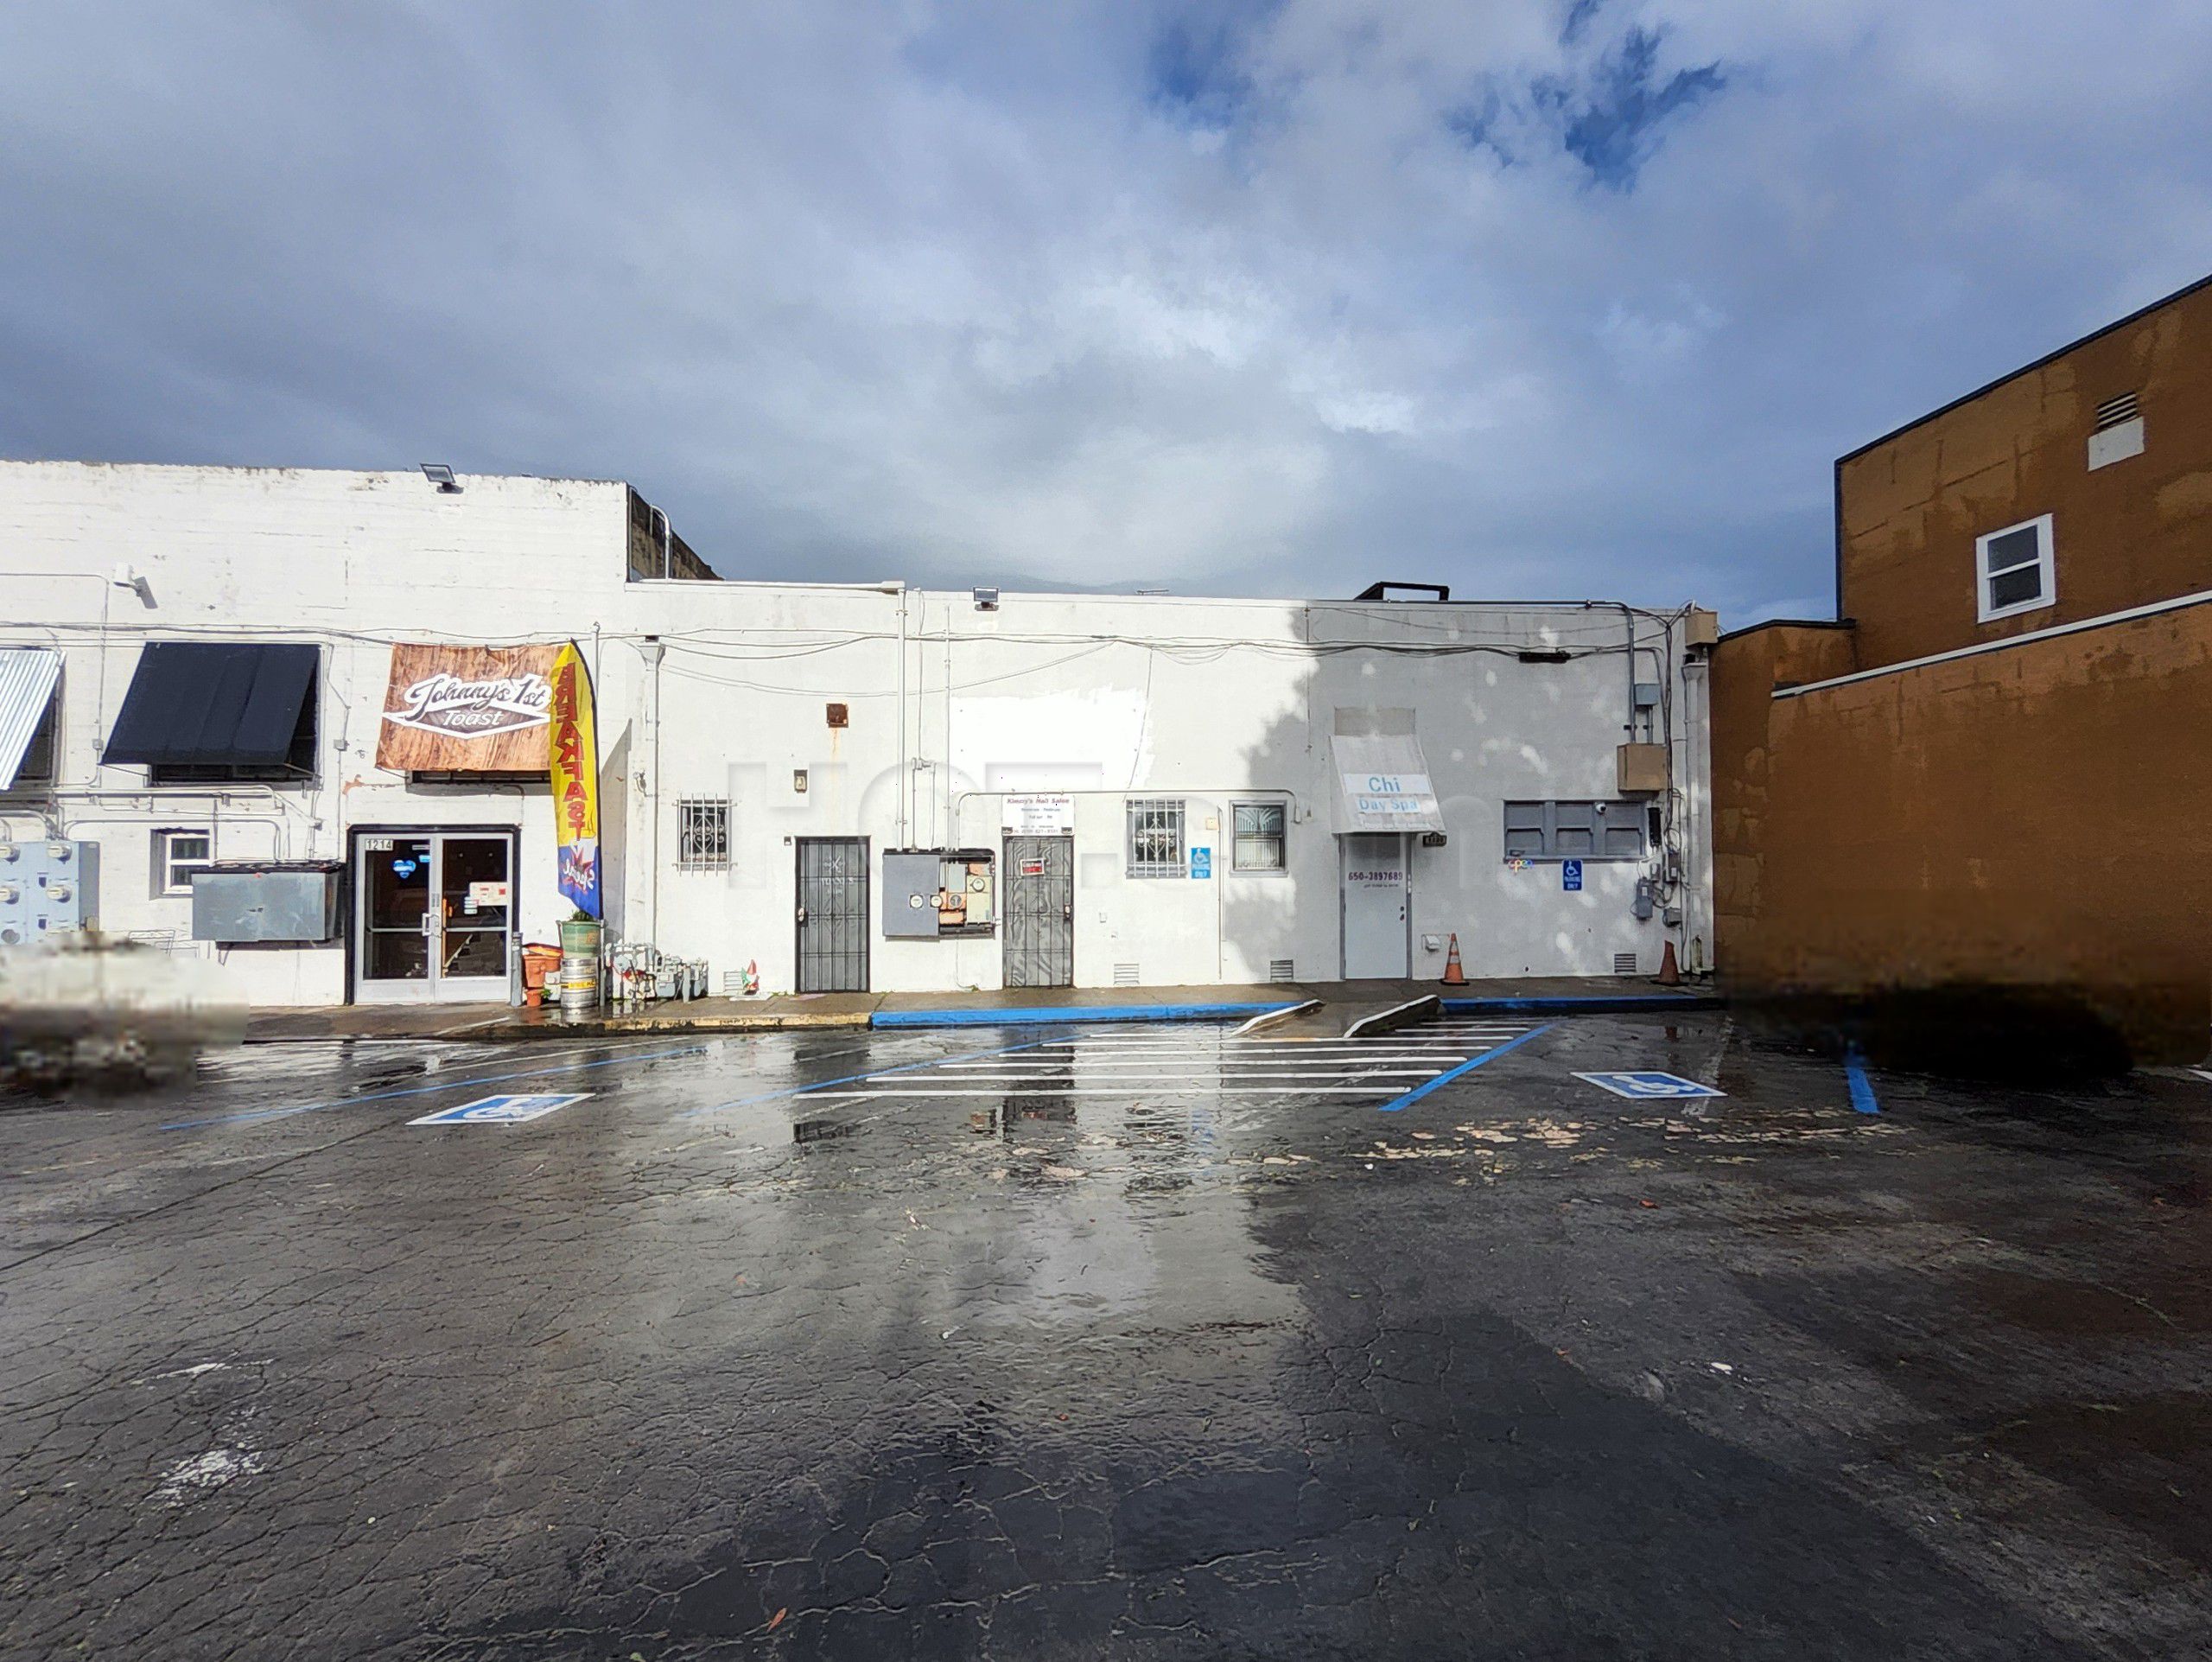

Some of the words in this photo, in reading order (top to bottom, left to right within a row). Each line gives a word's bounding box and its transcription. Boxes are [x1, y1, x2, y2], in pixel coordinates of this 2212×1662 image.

[404, 678, 512, 722] Johnny's
[512, 678, 546, 707] 1st
[442, 709, 504, 727] Toast
[1369, 777, 1401, 793] Chi
[1358, 795, 1387, 812] Day
[1390, 796, 1419, 812] Spa
[366, 839, 391, 850] 1214
